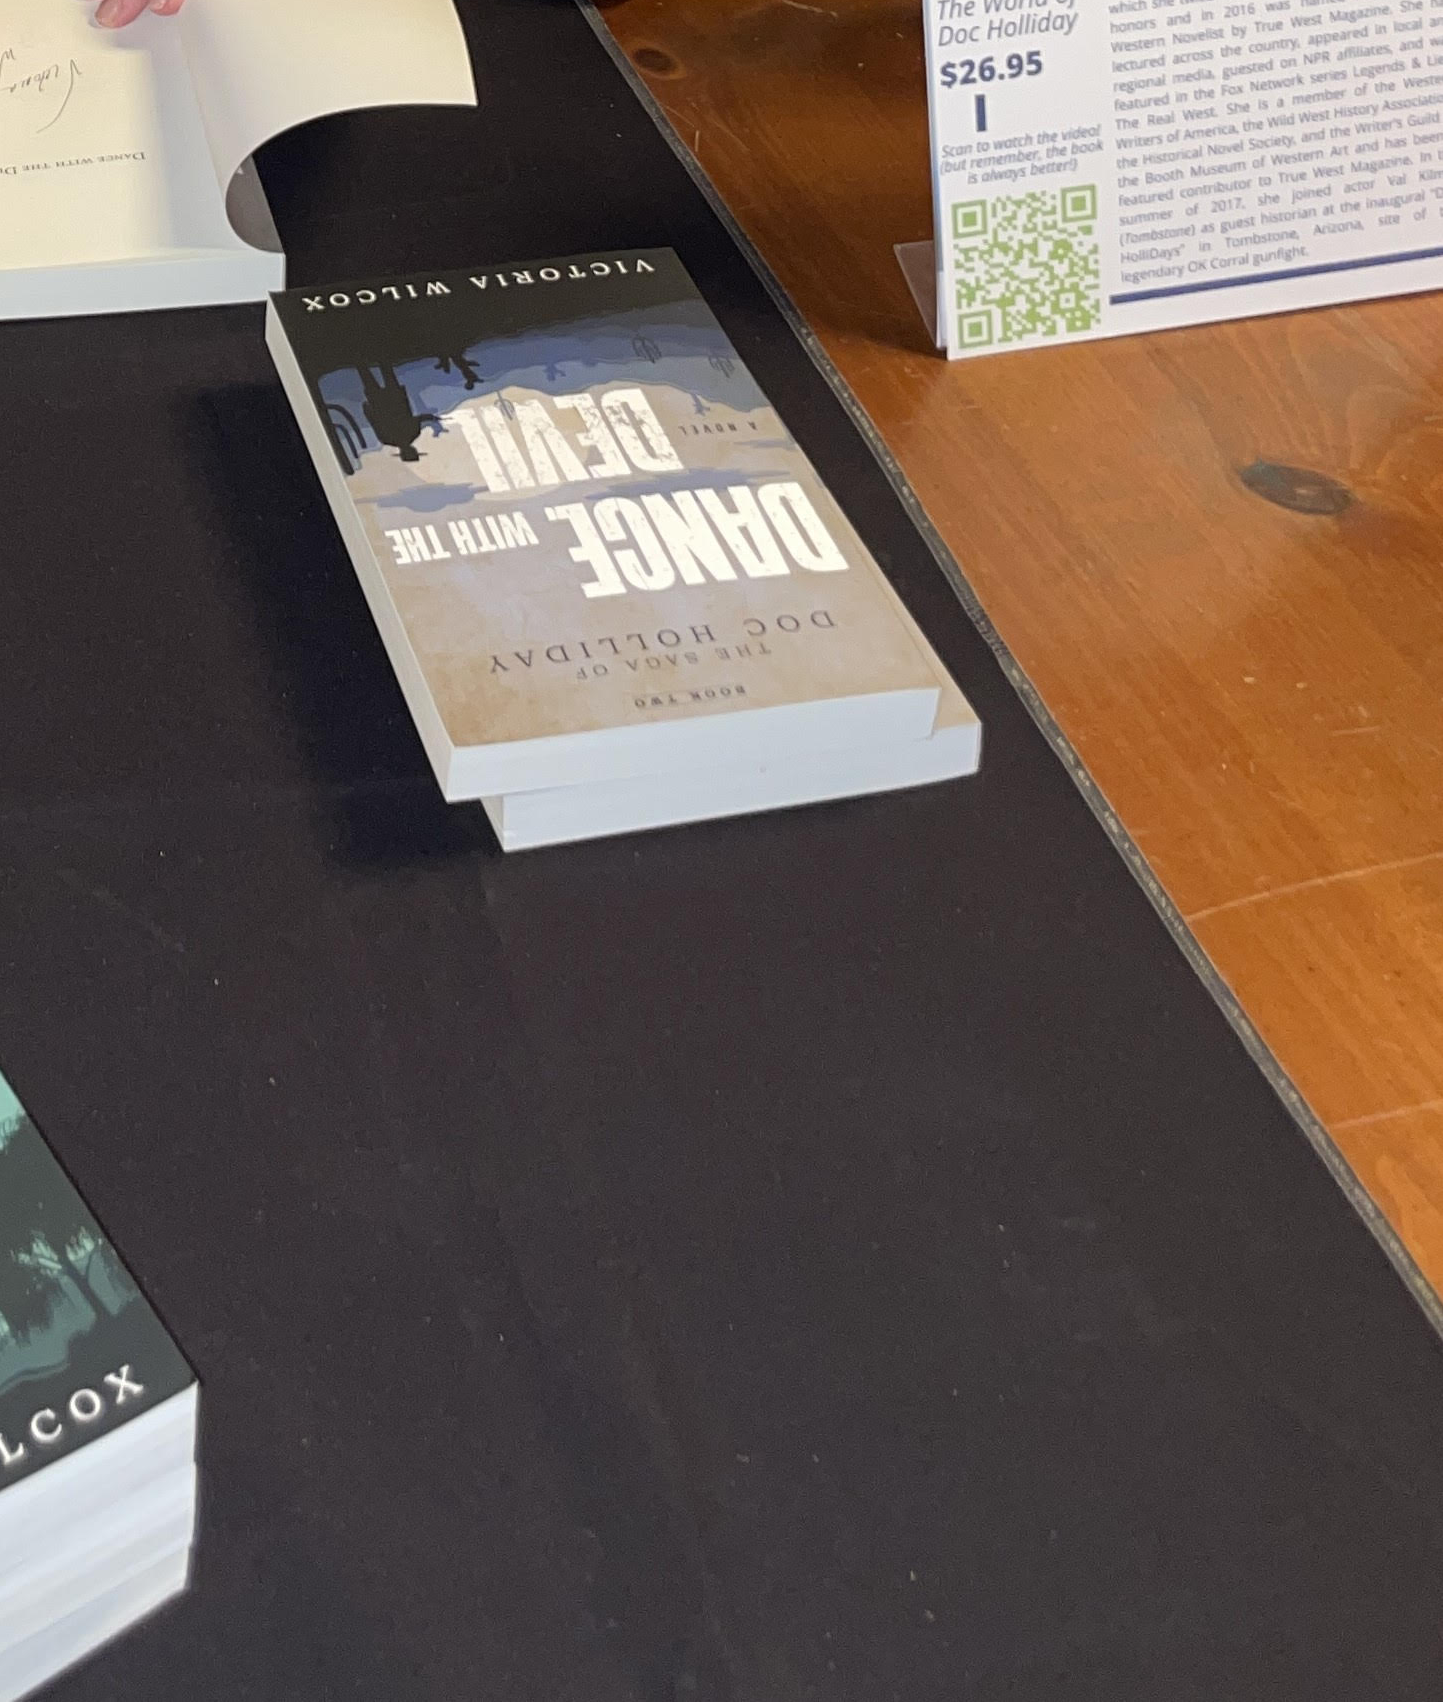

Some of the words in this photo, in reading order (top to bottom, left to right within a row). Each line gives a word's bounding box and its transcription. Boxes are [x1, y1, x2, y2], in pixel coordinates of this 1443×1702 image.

[938, 26, 980, 46] Doc
[987, 11, 1078, 40] Holliday
[940, 50, 1043, 88] $26.95
[470, 257, 655, 289] VICTORIA
[300, 280, 451, 313] WILCOX
[679, 421, 740, 438] NOVEL
[749, 421, 758, 431] A
[385, 524, 452, 565] THE
[457, 512, 540, 555] WITH
[544, 482, 850, 599] DANCE
[743, 610, 835, 637] DOC
[487, 625, 716, 675] HOLLIDAY
[624, 651, 698, 672] SAGA
[718, 641, 772, 660] THE
[575, 662, 609, 681] OF
[635, 693, 682, 710] TWO
[696, 684, 746, 700] BOOK
